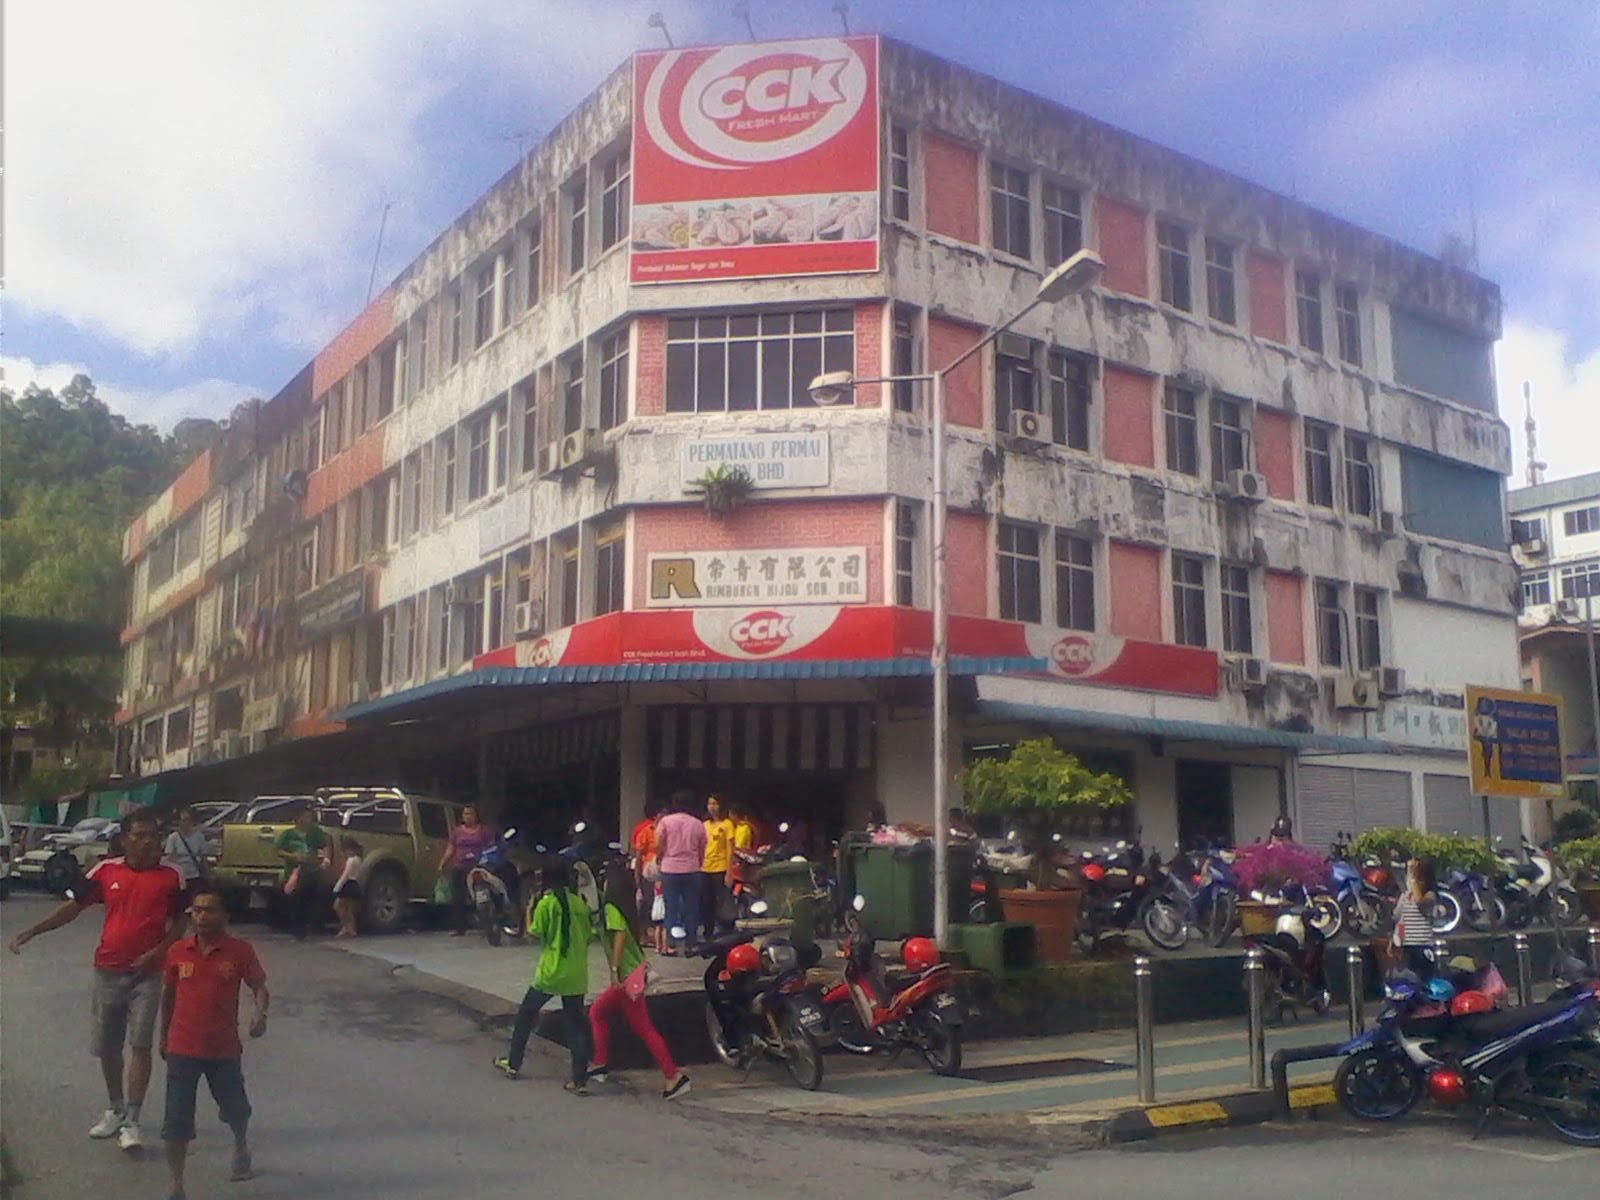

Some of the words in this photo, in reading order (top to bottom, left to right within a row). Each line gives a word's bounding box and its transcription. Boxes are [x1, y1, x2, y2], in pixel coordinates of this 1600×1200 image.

[701, 60, 848, 120] CCK
[727, 115, 775, 132] FRESH
[779, 111, 816, 124] MART
[772, 439, 820, 459] PERMAI
[757, 462, 784, 480] BHD
[706, 554, 861, 583] 常青有限公司
[729, 616, 796, 642] CCK
[1051, 642, 1096, 663] CCK
